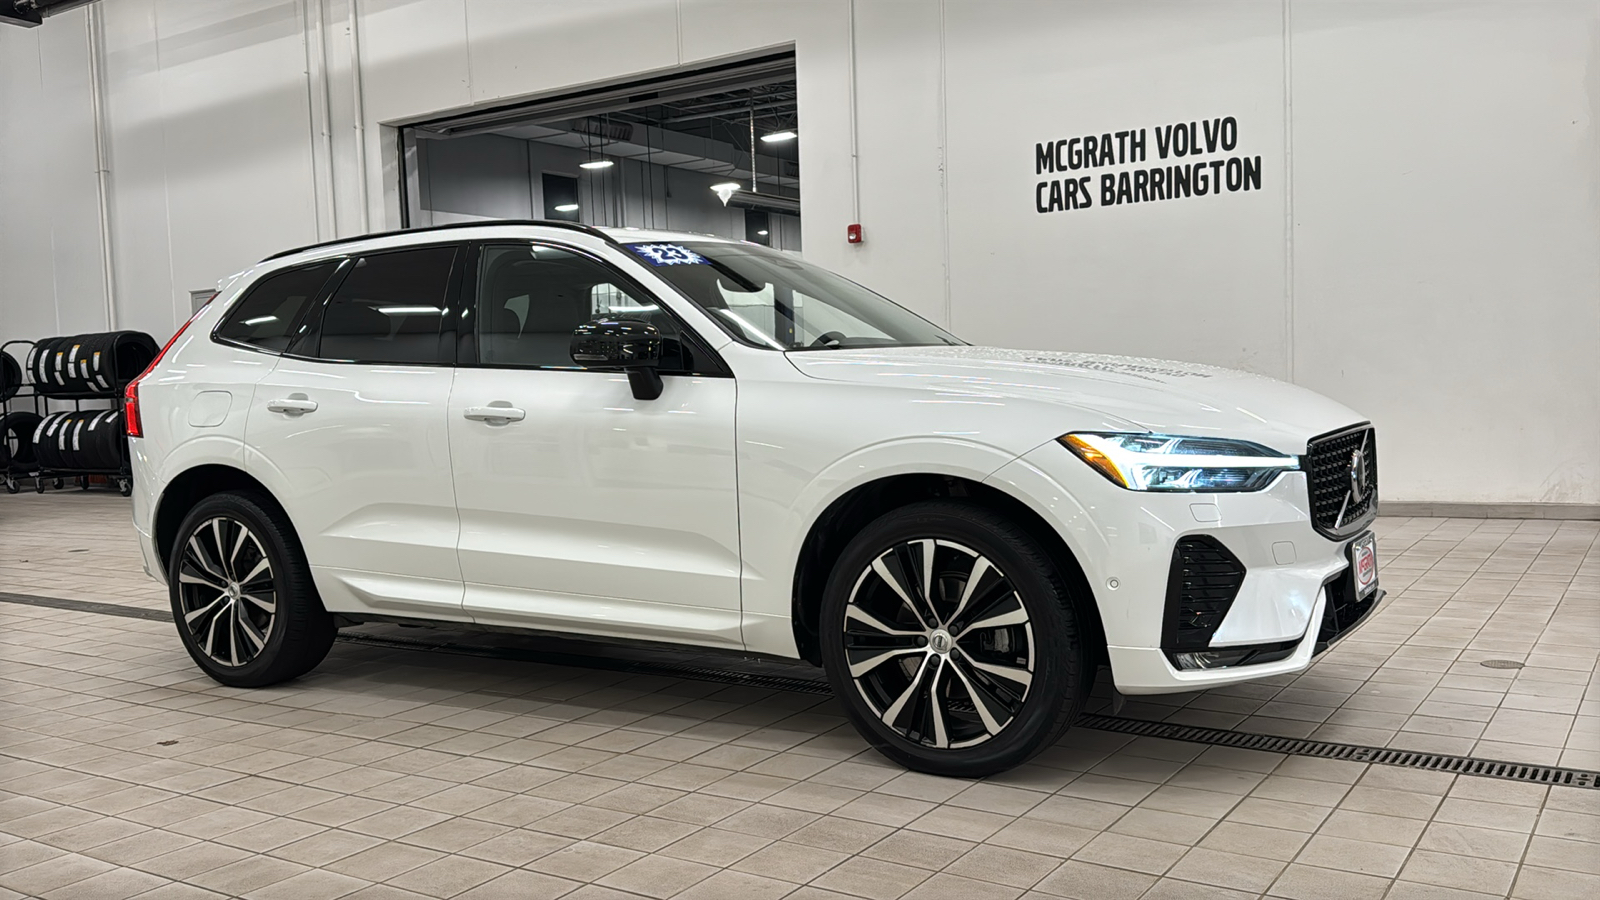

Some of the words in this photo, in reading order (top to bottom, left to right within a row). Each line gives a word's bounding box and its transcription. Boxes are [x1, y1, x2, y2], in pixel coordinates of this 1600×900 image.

[1035, 128, 1146, 175] MCGRATH
[1155, 116, 1238, 159] VOLVO
[1035, 176, 1093, 213] CARS
[1100, 155, 1262, 207] BARRINGTON
[651, 247, 689, 260] 23
